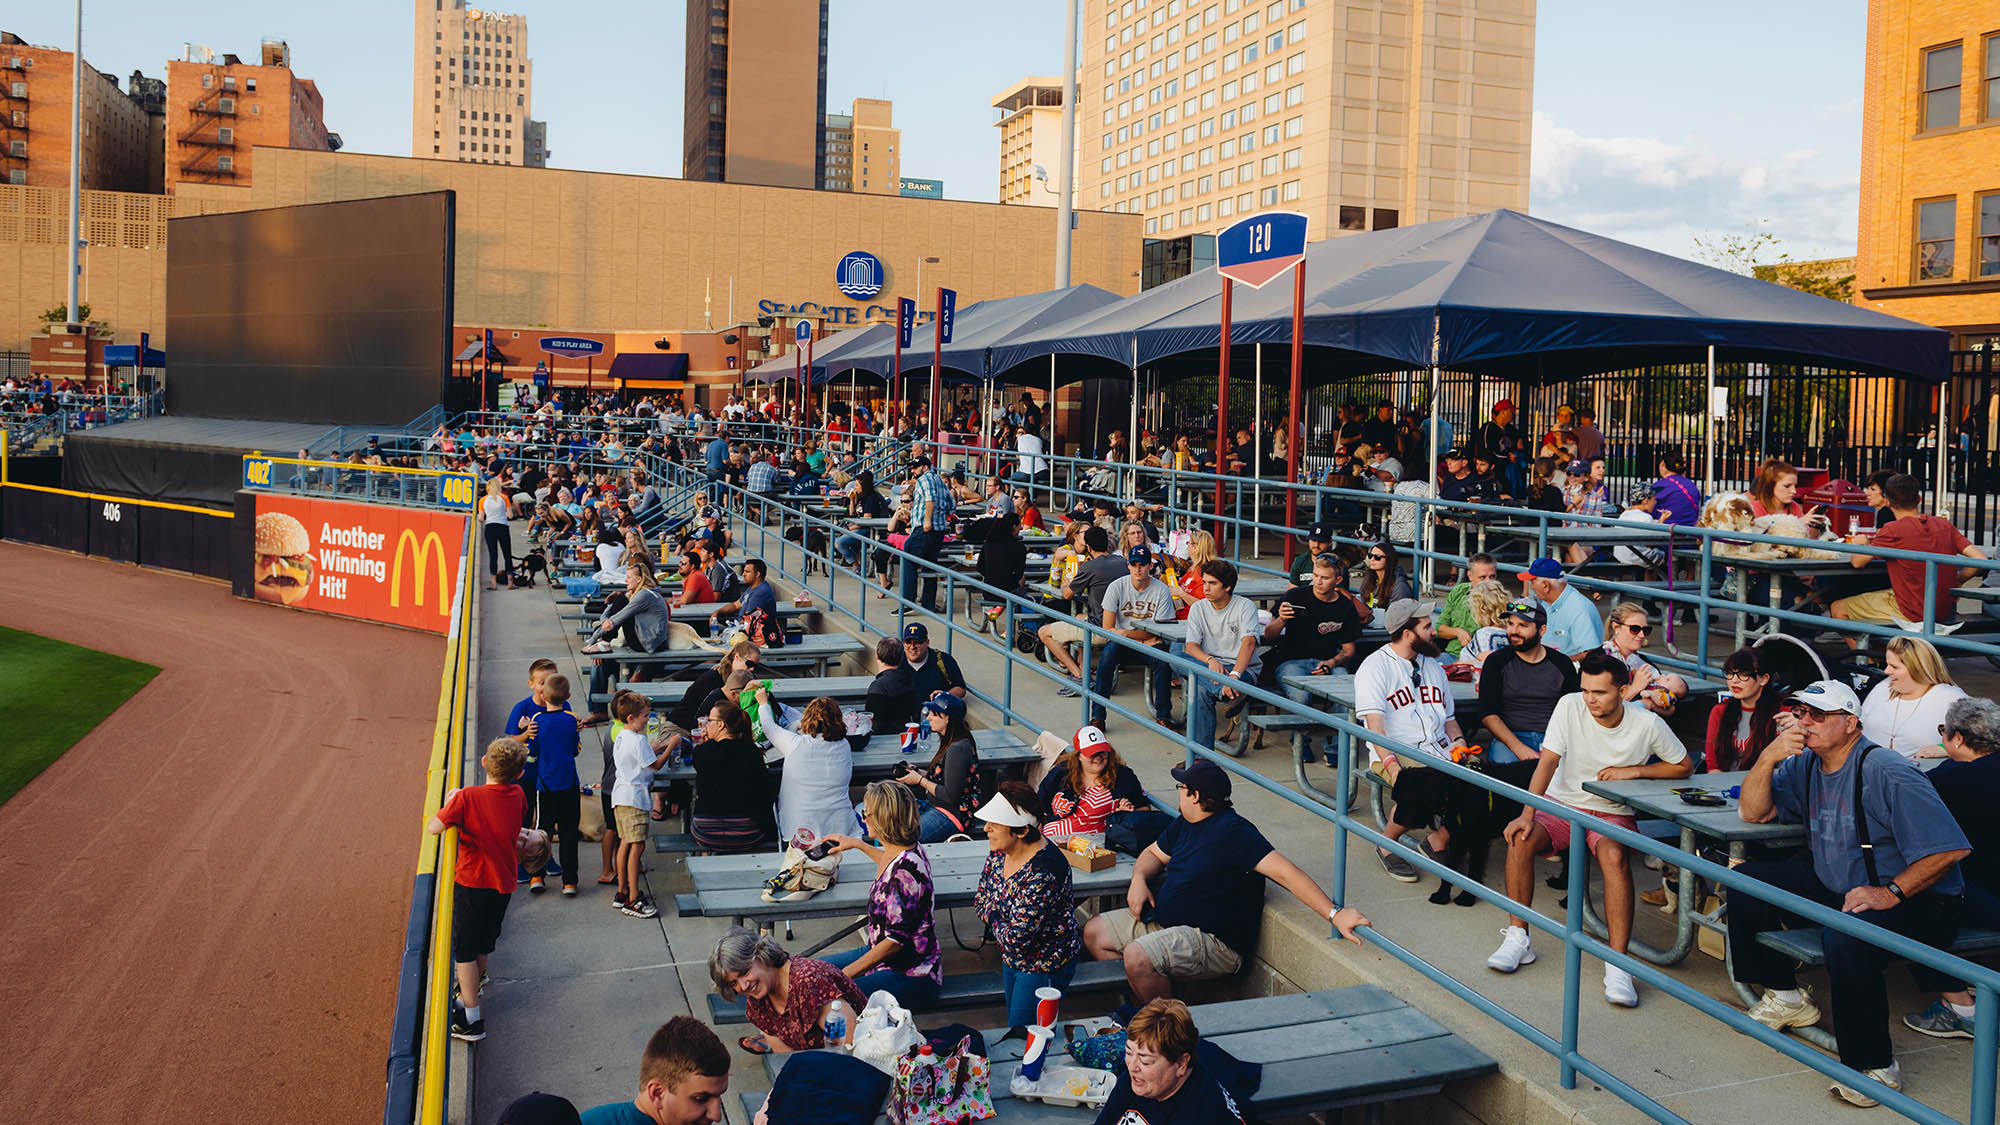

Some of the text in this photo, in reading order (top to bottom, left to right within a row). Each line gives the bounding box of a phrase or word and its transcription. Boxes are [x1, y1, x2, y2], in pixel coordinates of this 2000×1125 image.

[482, 10, 509, 22] PNC
[907, 182, 932, 191] BANK
[1249, 222, 1271, 254] 120
[566, 341, 579, 349] PLAY
[247, 461, 269, 485] 402
[442, 478, 472, 504] 406
[103, 502, 121, 522] 406
[320, 522, 385, 551] Another
[319, 548, 386, 583] Winning
[319, 575, 347, 600] Hit!
[909, 626, 918, 634] T
[1088, 732, 1098, 743] C
